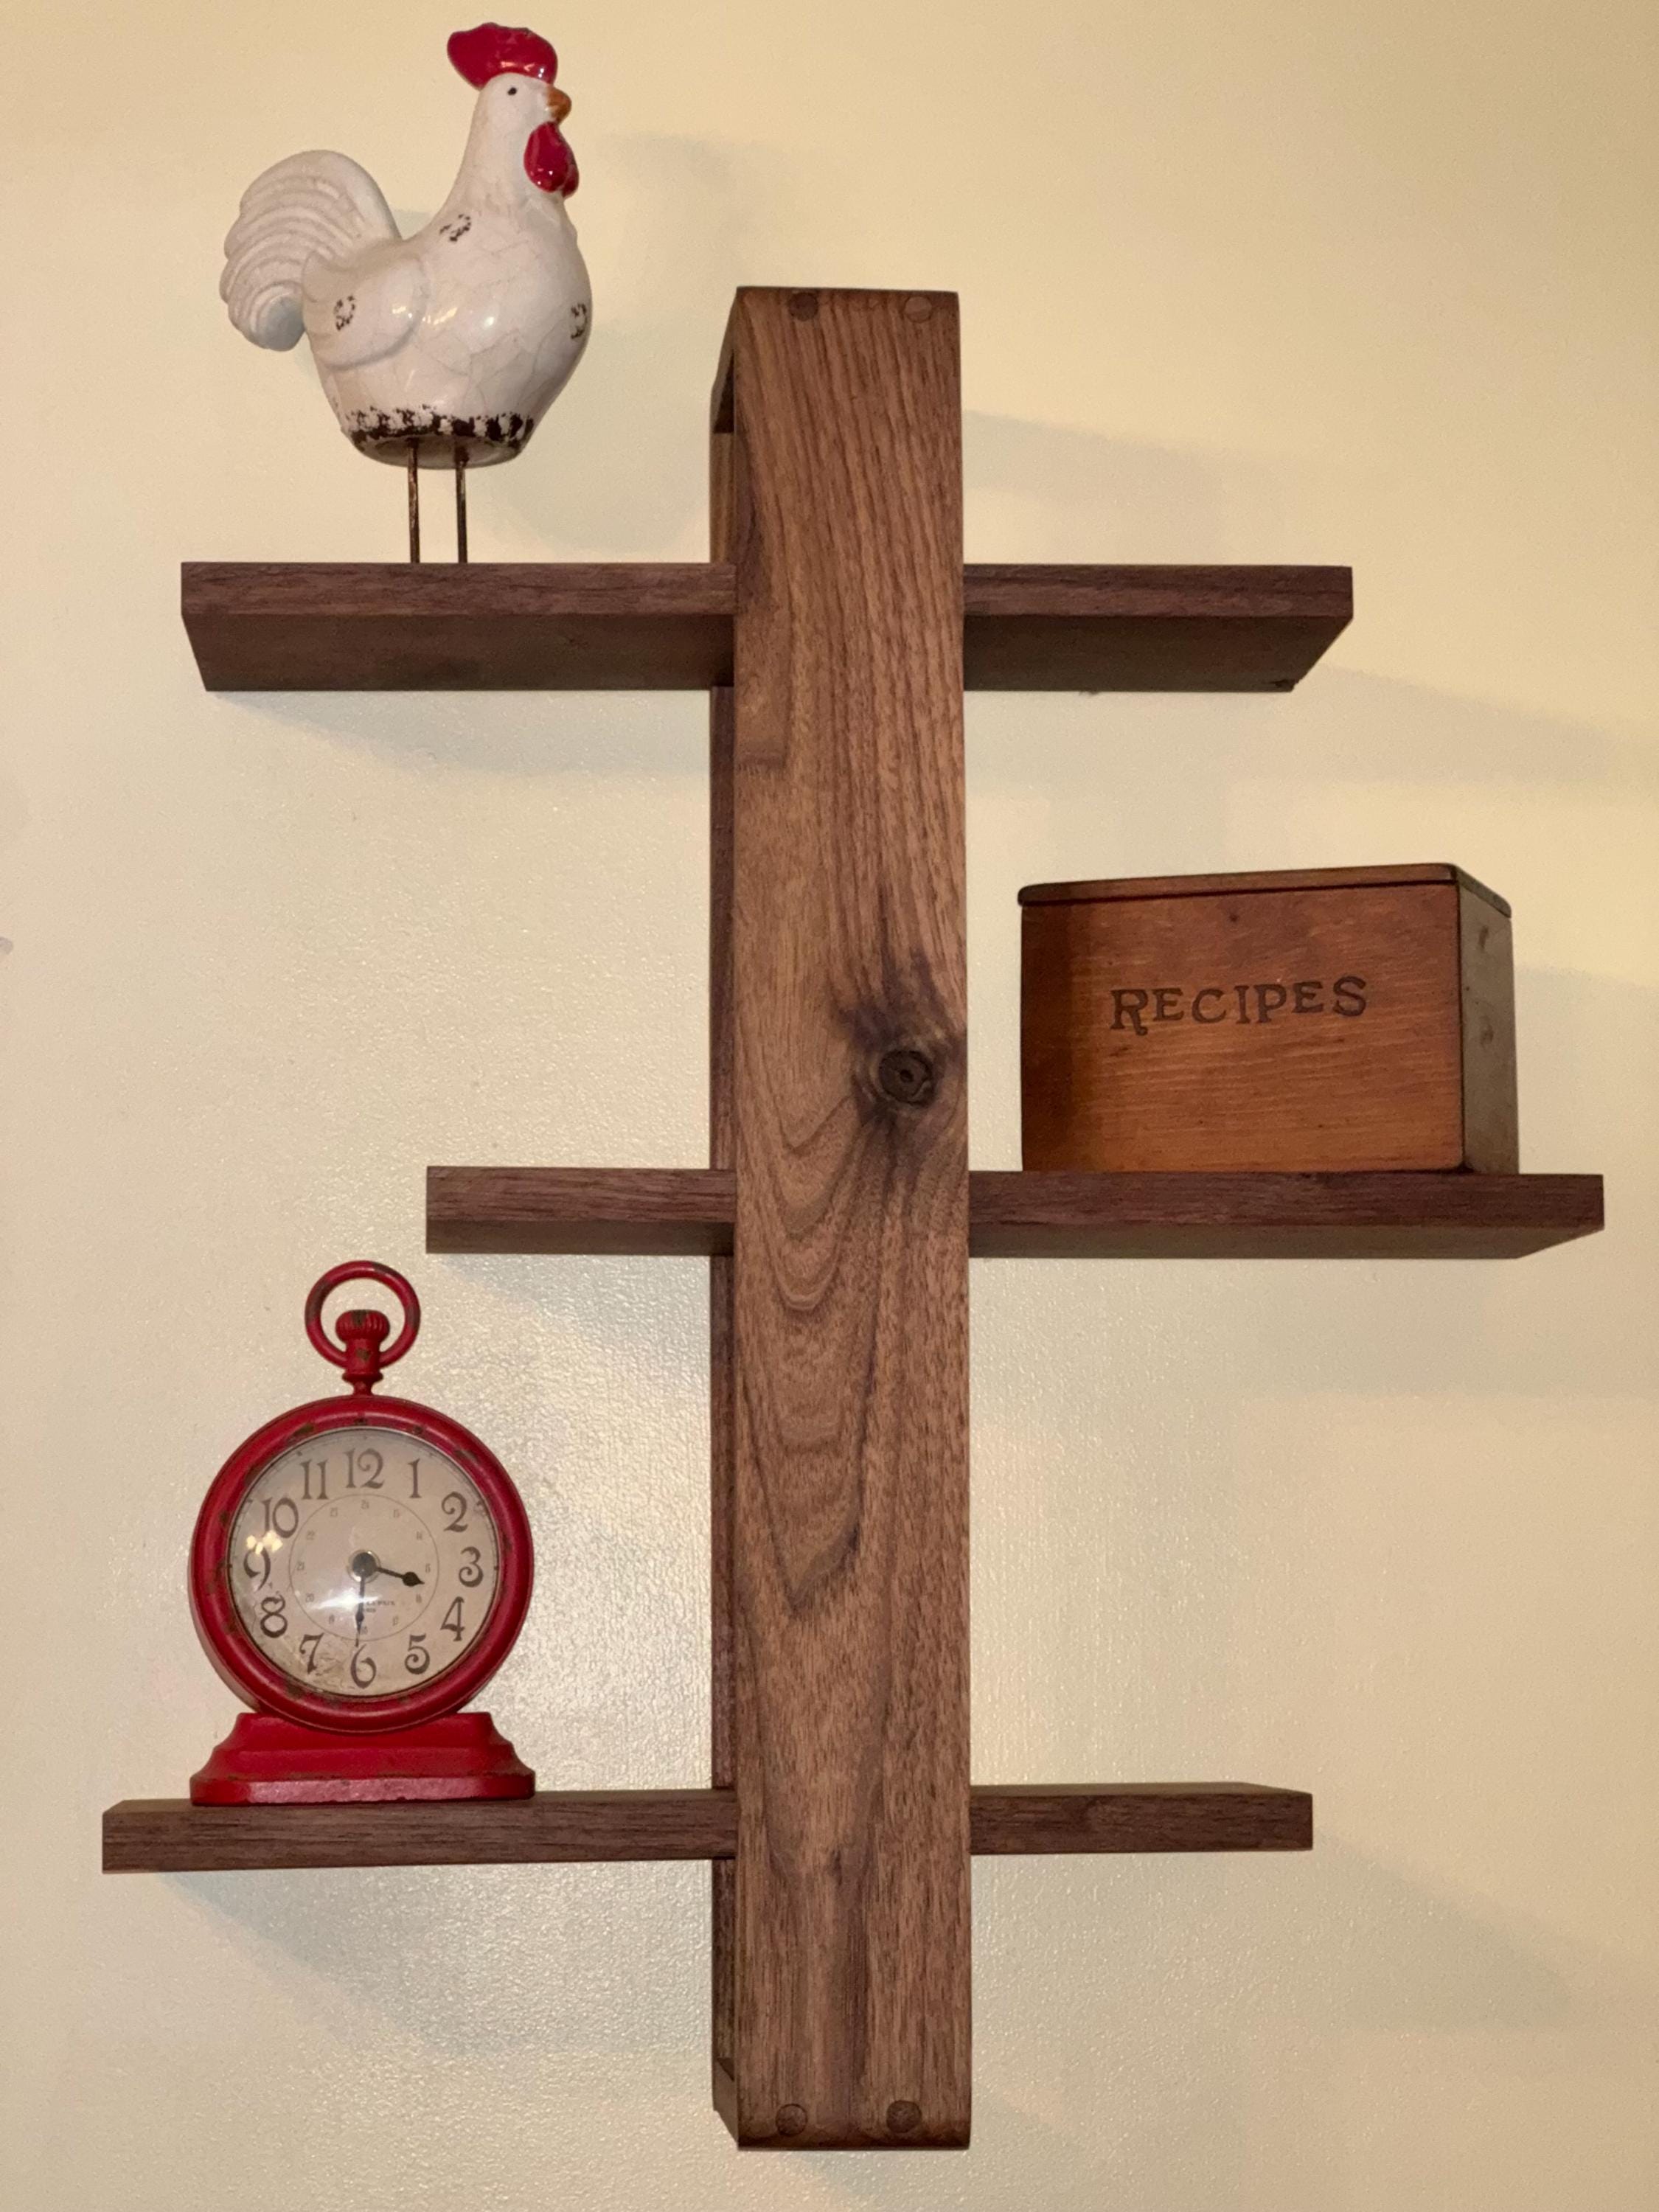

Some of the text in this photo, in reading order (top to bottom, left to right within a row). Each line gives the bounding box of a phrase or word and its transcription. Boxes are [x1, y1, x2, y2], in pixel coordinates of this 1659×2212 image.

[1110, 975, 1367, 1036] RECIPES
[300, 1458, 330, 1500] 11
[343, 1448, 384, 1489] 12
[407, 1458, 422, 1499] 1
[261, 1496, 299, 1539] 10
[442, 1491, 468, 1532] 2
[243, 1543, 271, 1591] 9
[459, 1546, 484, 1587] 3
[260, 1596, 288, 1638] 8
[440, 1596, 465, 1641] 4
[299, 1632, 324, 1674] 7
[350, 1644, 377, 1688] 6
[404, 1634, 430, 1674] 5
